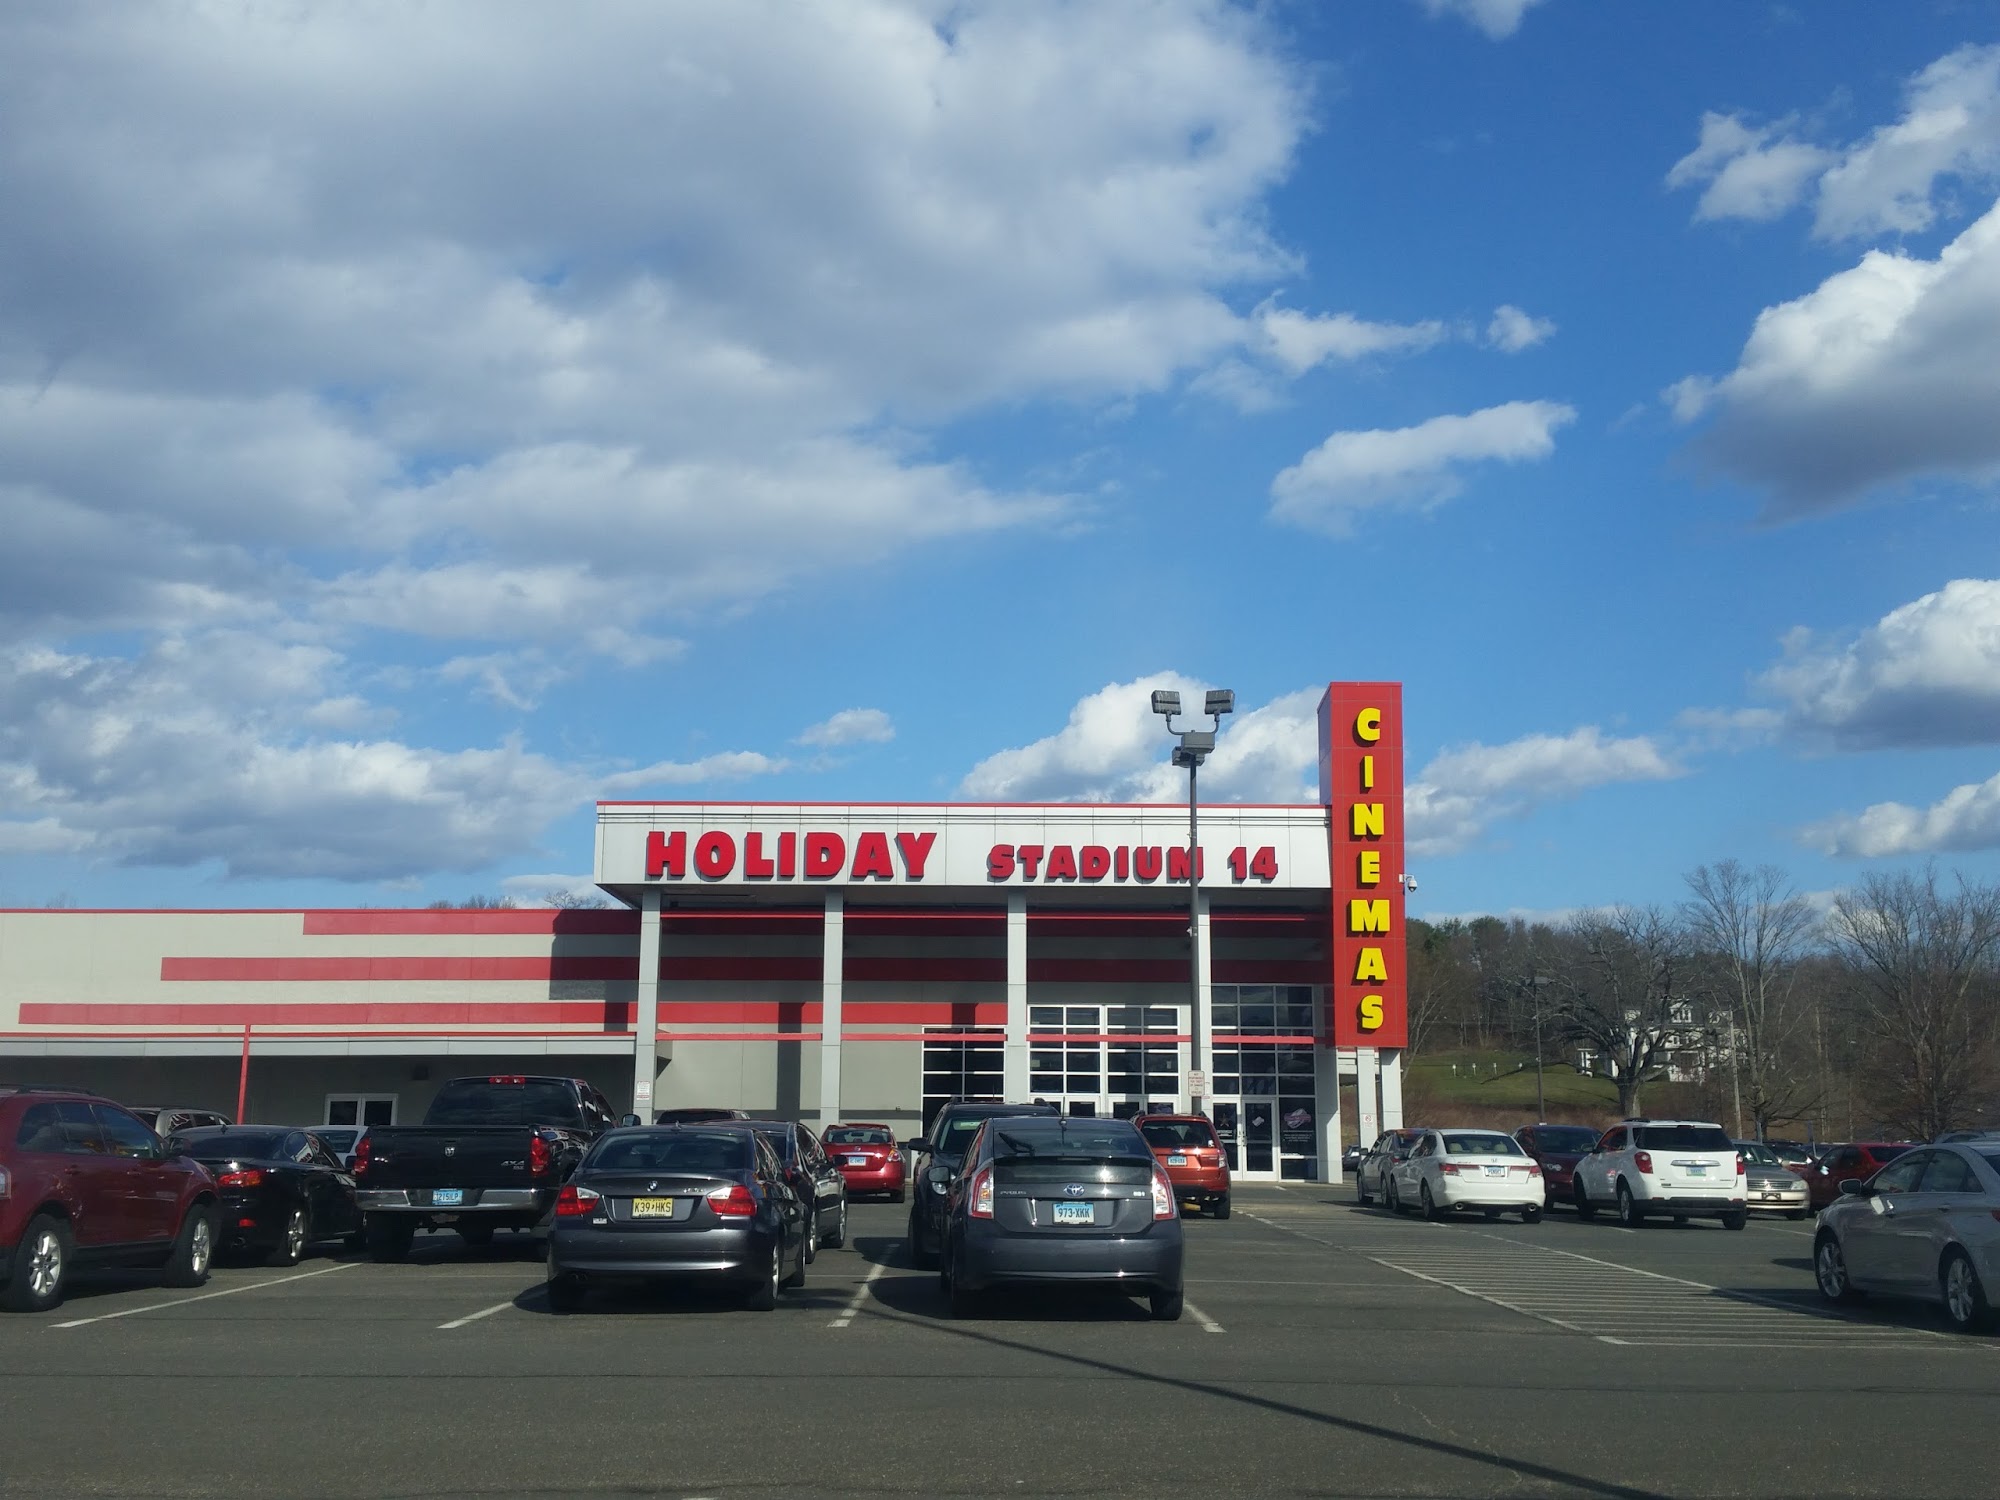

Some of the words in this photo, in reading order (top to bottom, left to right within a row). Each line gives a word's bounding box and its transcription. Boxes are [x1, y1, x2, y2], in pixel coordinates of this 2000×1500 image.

[645, 831, 937, 881] HOLIDAY
[987, 844, 1204, 882] STADIUM
[1228, 846, 1278, 881] 14
[1350, 707, 1390, 1030] CINEMAS
